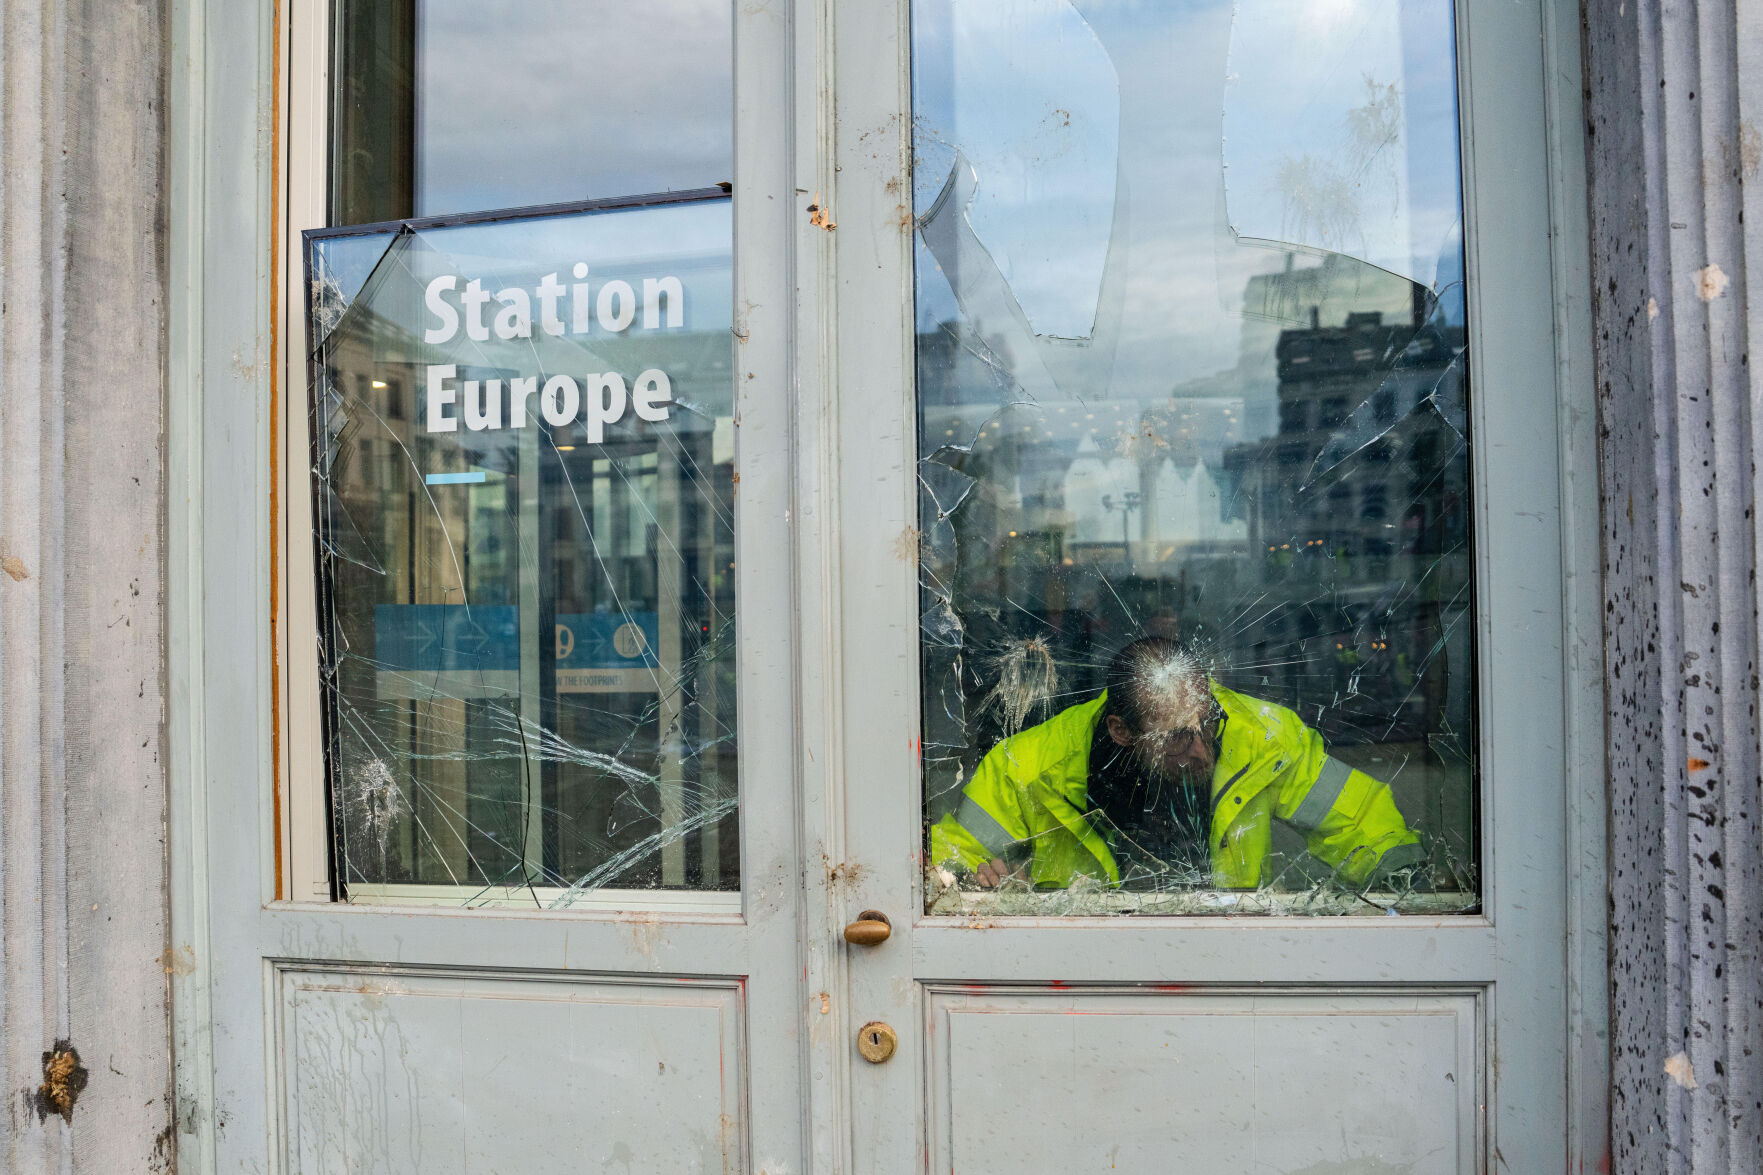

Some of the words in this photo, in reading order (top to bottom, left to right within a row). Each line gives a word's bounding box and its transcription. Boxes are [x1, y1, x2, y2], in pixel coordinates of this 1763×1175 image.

[424, 262, 684, 344] Station
[426, 364, 673, 444] Europe
[565, 675, 578, 687] THE
[579, 675, 624, 686] FOOTPRINTS
